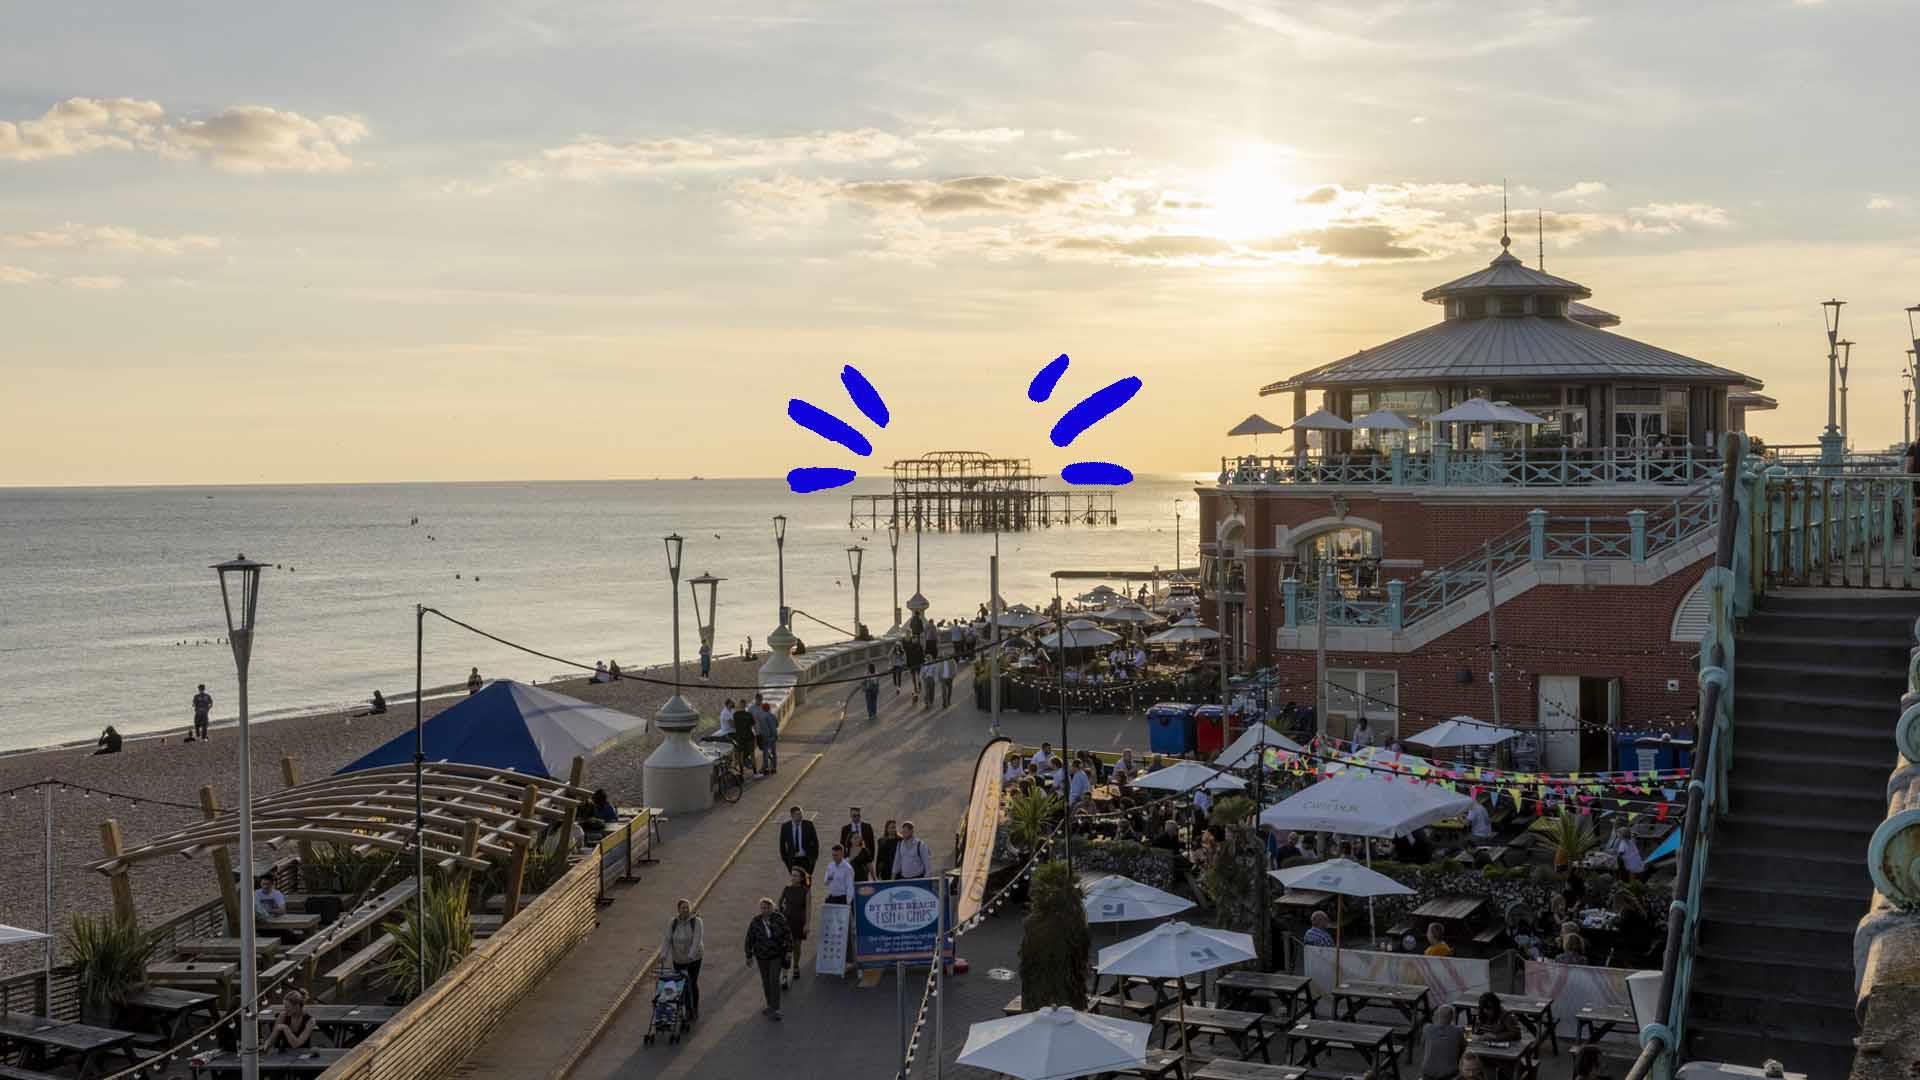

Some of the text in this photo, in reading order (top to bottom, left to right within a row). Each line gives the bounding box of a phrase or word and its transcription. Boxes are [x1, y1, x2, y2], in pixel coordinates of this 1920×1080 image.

[883, 902, 904, 911] THE
[906, 901, 936, 909] BEACH
[876, 911, 896, 924] FISH
[907, 909, 933, 922] CHIPS
